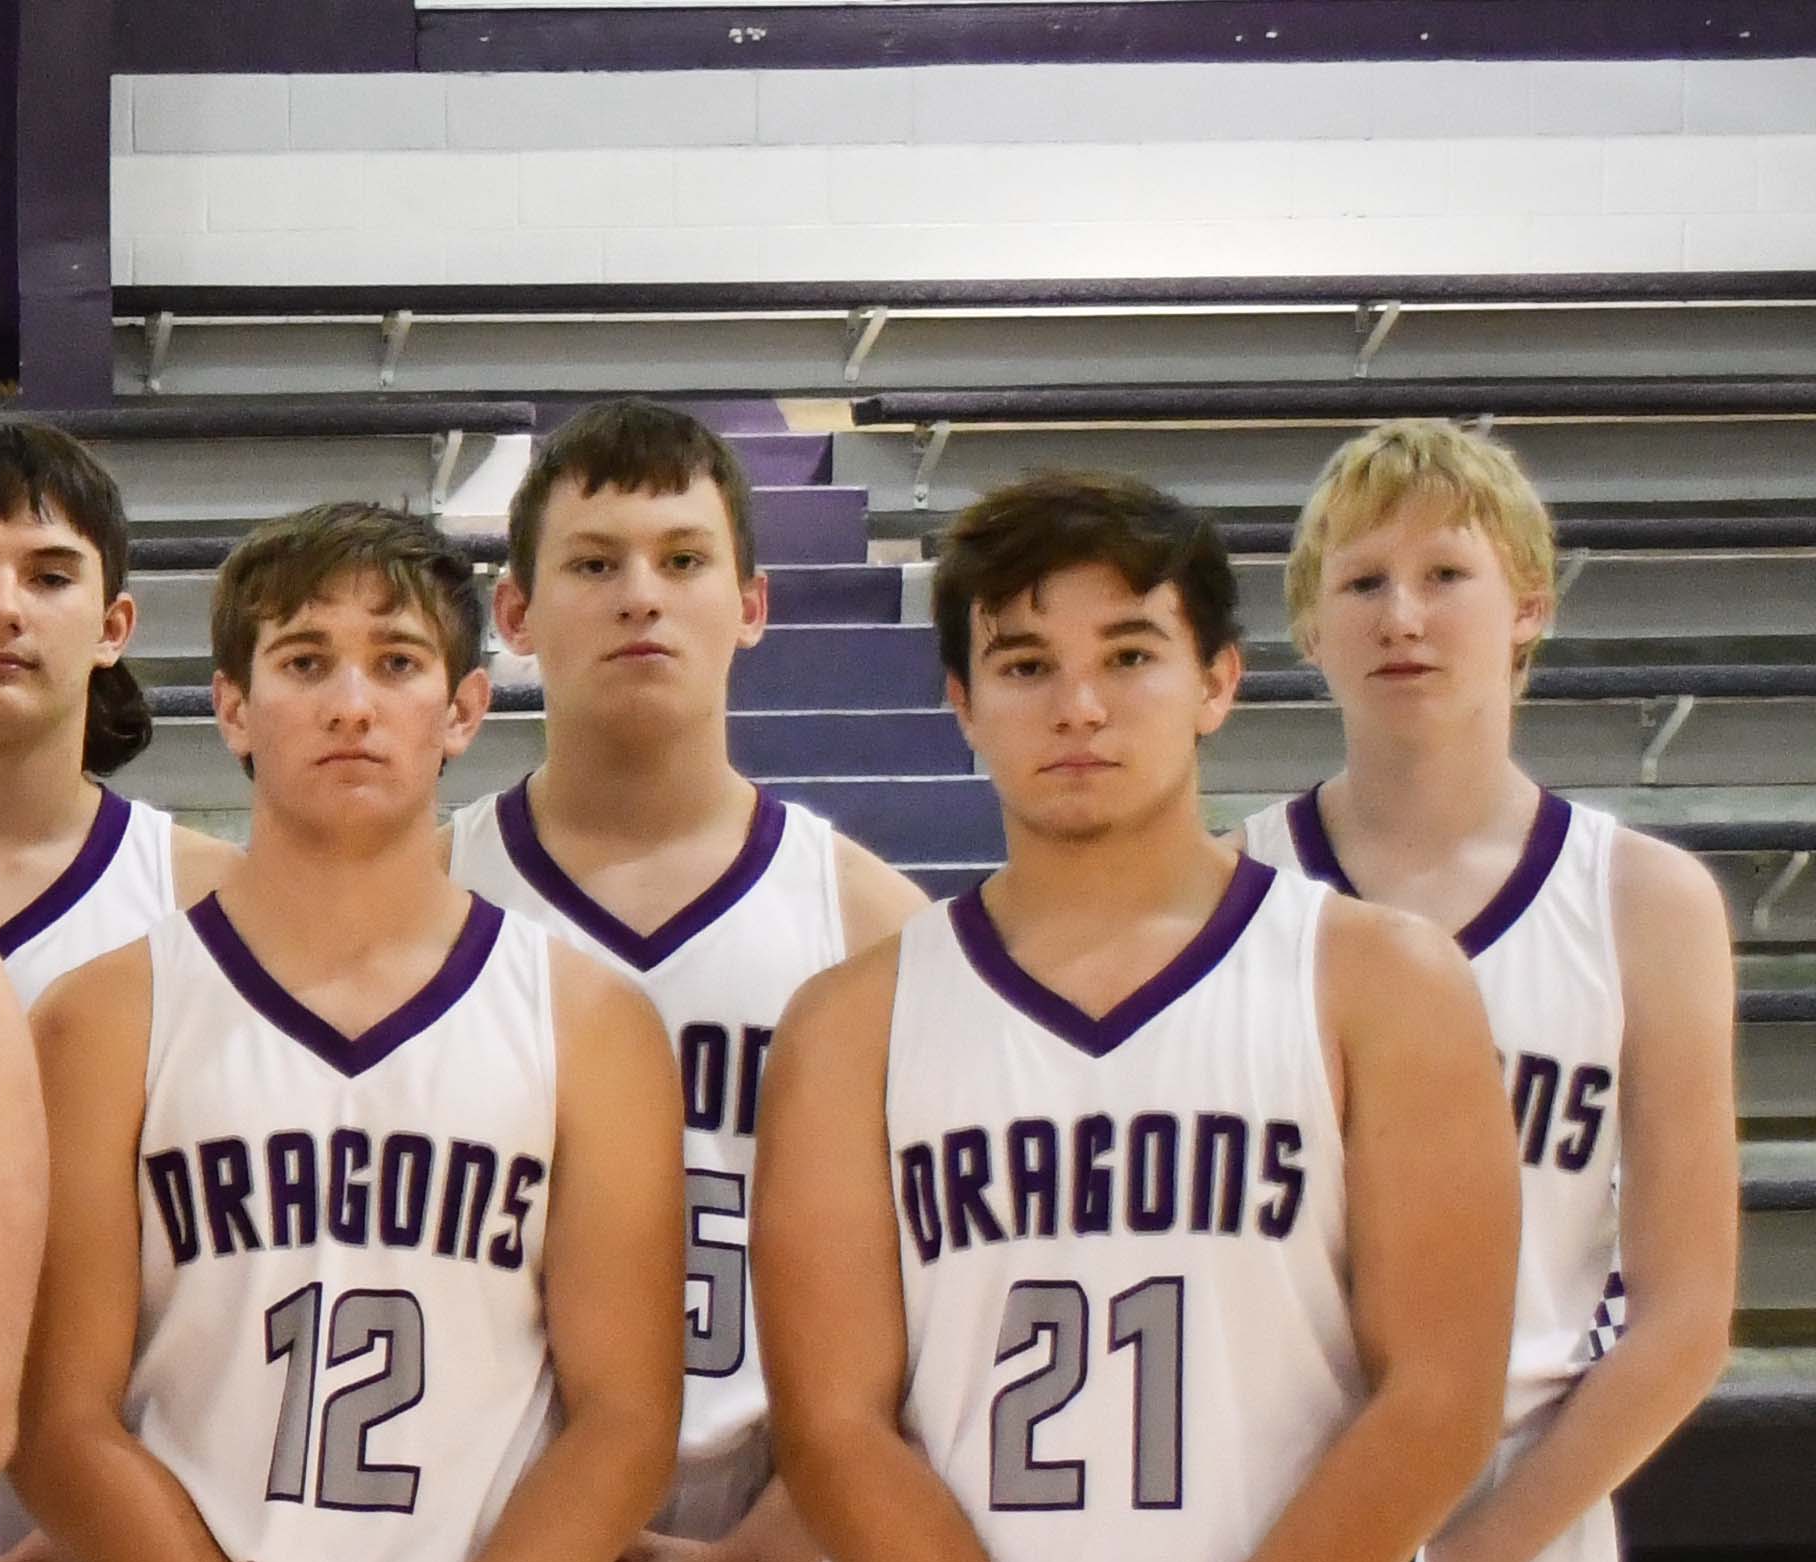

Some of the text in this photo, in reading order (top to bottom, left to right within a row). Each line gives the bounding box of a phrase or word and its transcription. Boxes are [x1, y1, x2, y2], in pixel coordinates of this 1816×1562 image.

[143, 1128, 546, 1272] DRAGONS
[895, 1111, 1308, 1266] DRAGONS
[264, 1281, 426, 1516] 12
[989, 1275, 1185, 1513] 21
